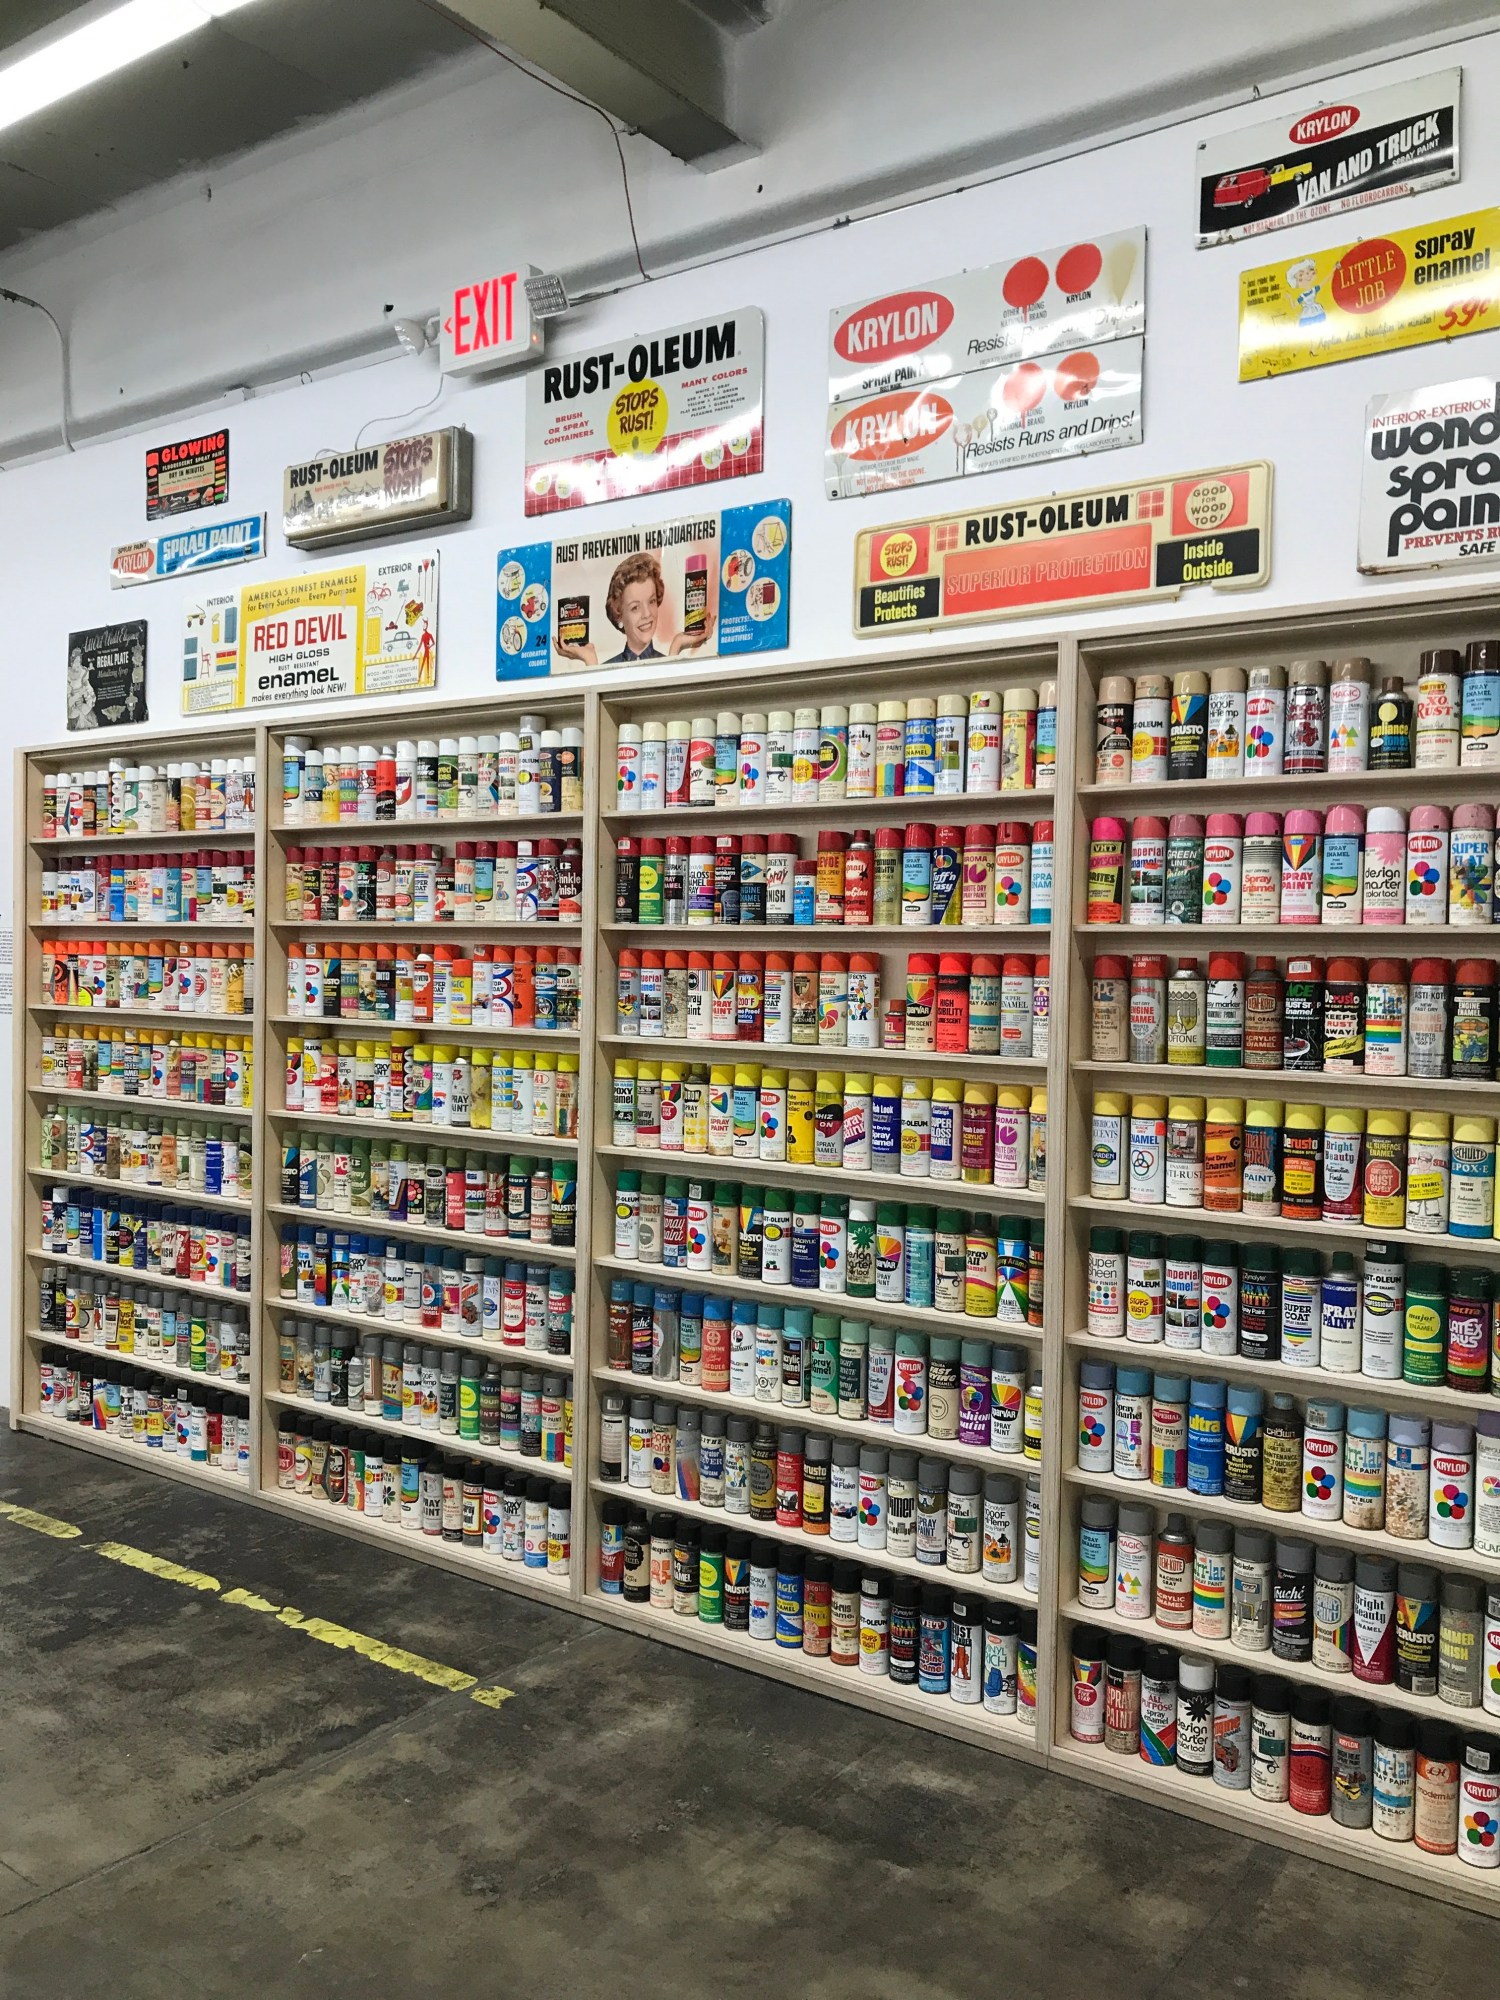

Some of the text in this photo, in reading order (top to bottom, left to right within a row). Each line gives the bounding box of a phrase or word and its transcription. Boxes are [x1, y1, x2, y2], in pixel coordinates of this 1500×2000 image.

[1297, 109, 1351, 141] KRYLON
[1297, 113, 1440, 205] VAN AND TRUCK
[1392, 139, 1439, 167] SPRAY PAINT
[1287, 213, 1295, 223] TO
[1296, 210, 1308, 221] THE
[1310, 204, 1331, 218] OZONE
[1341, 199, 1351, 209] NO
[1414, 227, 1475, 260] spray
[1339, 250, 1396, 289] LITTLE
[1414, 248, 1490, 285] enamel
[1066, 291, 1091, 304] KRYLON
[1355, 283, 1386, 309] JOB
[454, 273, 517, 356] EXIT
[1003, 307, 1020, 318] OTHER
[1029, 311, 1047, 321] BRAND
[848, 301, 938, 355] KRYLON
[544, 320, 735, 404] RUST-OLEUM
[681, 367, 748, 389] MANY COLORS
[616, 387, 659, 415] STOPS
[1064, 400, 1089, 411] KRYLON
[556, 411, 583, 423] BRUSH
[1372, 399, 1491, 428] INTERIOR-EXTERIOR
[563, 420, 589, 432] SPRAY
[620, 413, 654, 435] RUST!
[844, 402, 937, 448] KRYLON
[1027, 416, 1045, 426] BRAND
[544, 429, 594, 445] CONTAINERS
[966, 435, 1019, 459] Resists
[1019, 430, 1055, 446] Runs
[1059, 420, 1088, 440] and
[1091, 410, 1135, 434] Drips!
[162, 434, 225, 463] GLOWING
[383, 436, 432, 471] STOPS
[195, 454, 210, 464] SPRAY
[212, 450, 225, 458] PAINT
[169, 471, 177, 479] DRY
[185, 465, 204, 475] MINUTES
[290, 450, 378, 489] RUST-OLEUM
[1193, 486, 1226, 500] GOOD
[1191, 502, 1227, 515] WOOD
[965, 494, 1129, 547] RUST-OLEUM
[1194, 514, 1224, 527] TOO!
[162, 532, 206, 561] SPRAY
[209, 522, 253, 552] PAINT
[1404, 529, 1483, 549] PREVENTS
[118, 542, 147, 554] SPRAY PAINT
[556, 543, 579, 564] RUST
[583, 533, 640, 561] PREVENTION
[884, 538, 913, 555] STOPS
[1183, 539, 1224, 561] Inside
[1459, 541, 1496, 556] SAFE
[117, 552, 149, 573] KRYLON
[886, 553, 910, 568] RUST!
[378, 563, 412, 576] EXTERIOR
[946, 546, 1148, 595] SUPERIOR PROTECTION
[1182, 559, 1233, 582] Outside
[248, 574, 358, 602] AMERICA'S FINEST ENAMELS
[206, 595, 234, 607] INTERIOR
[247, 586, 357, 612] for Every Surface Every Purose
[874, 585, 925, 605] Beautifies
[874, 603, 917, 621] Protects
[254, 612, 347, 652] RED DEVIL
[721, 633, 753, 644] BEAUTIFIES!
[535, 635, 547, 647] 24
[97, 651, 128, 668] REGAL PLATE
[269, 648, 330, 664] HIGH GLOSS
[521, 649, 547, 659] DECORATOR
[294, 660, 319, 668] RESISTANT
[528, 658, 547, 667] COLORS!
[252, 682, 347, 703] makes everything look NEW!
[1417, 702, 1453, 719] RUST
[1371, 723, 1409, 737] appliance
[1409, 839, 1438, 850] KRYLON
[1451, 842, 1489, 854] SUPER
[1168, 850, 1197, 859] GREEN
[1205, 849, 1230, 859] KRYLON
[1244, 875, 1271, 885] Spray
[1282, 872, 1313, 881] SPRAY
[1365, 867, 1400, 880] design
[1242, 884, 1275, 893] Enamel
[1282, 882, 1313, 890] PAINT
[940, 998, 954, 1007] HIGH
[1459, 1002, 1480, 1010] ENGINE
[710, 1118, 730, 1127] SPRAY
[711, 1124, 729, 1132] PAINT
[1326, 1140, 1353, 1152] Bright
[1325, 1152, 1354, 1164] Beauty
[1205, 1160, 1236, 1170] Enamel
[1244, 1175, 1274, 1183] PAINT
[1370, 1174, 1393, 1186] RUST
[1203, 1276, 1228, 1285] KRYLON
[1130, 1297, 1149, 1306] STOPS
[1284, 1303, 1312, 1313] SUPER
[1284, 1311, 1310, 1321] COAT
[1322, 1305, 1357, 1318] SPRAY
[1323, 1316, 1355, 1329] PAINT
[898, 1362, 922, 1371] KRYLON
[1189, 1414, 1221, 1433] ultra
[1306, 1441, 1334, 1454] KRYLON
[1436, 1460, 1467, 1473] KRYLON
[918, 1519, 937, 1528] SPRAY
[1355, 1594, 1385, 1610] Bright
[1144, 1716, 1169, 1725] enamel
[1146, 1709, 1166, 1719] spray
[1467, 1785, 1498, 1798] KRYLON
